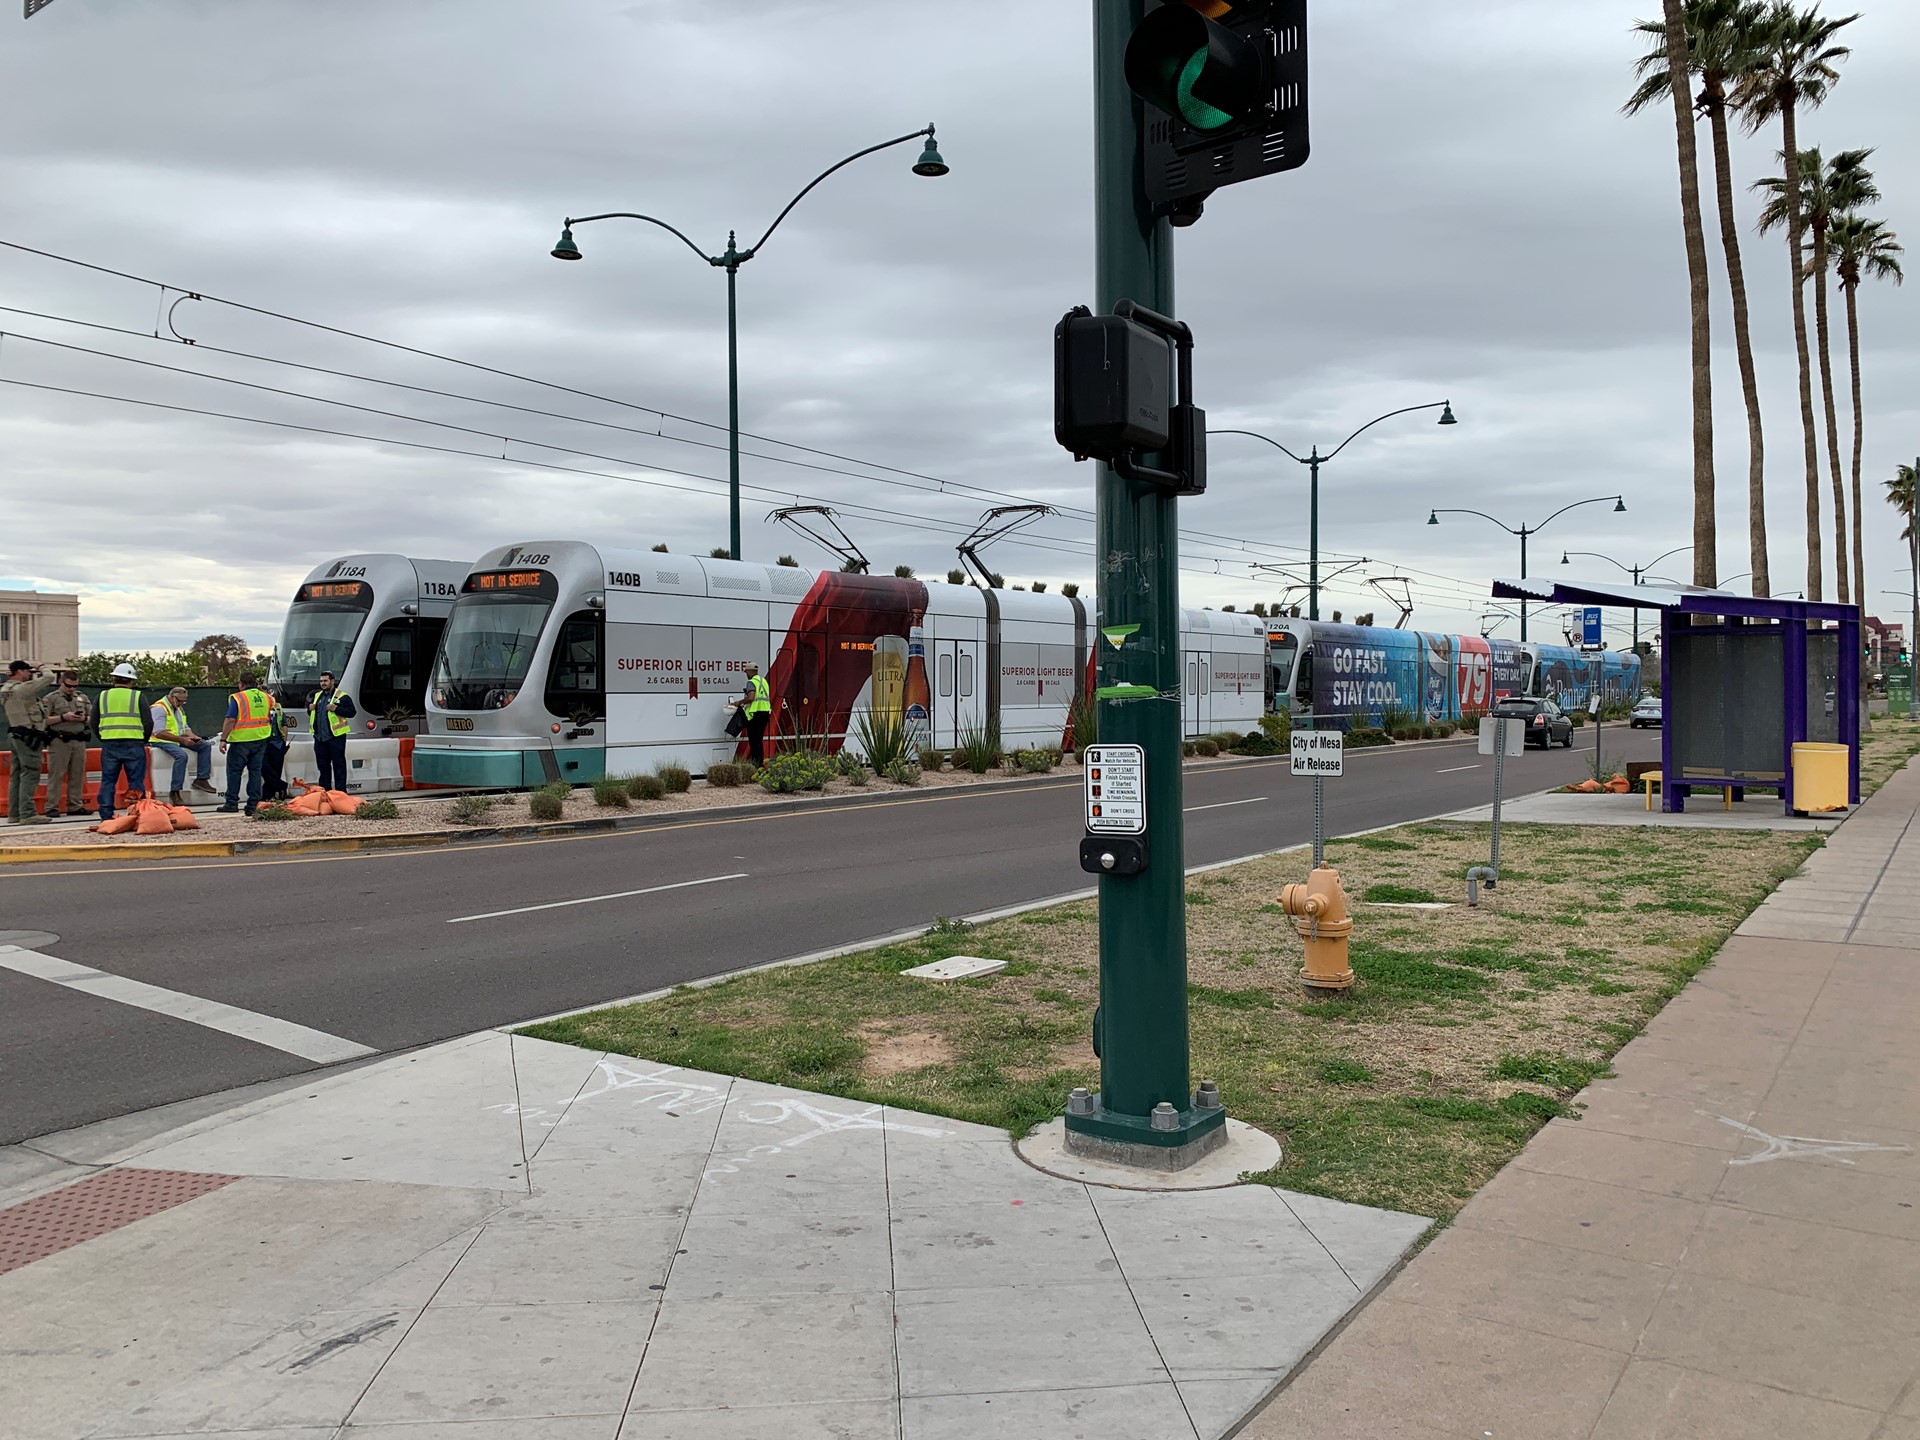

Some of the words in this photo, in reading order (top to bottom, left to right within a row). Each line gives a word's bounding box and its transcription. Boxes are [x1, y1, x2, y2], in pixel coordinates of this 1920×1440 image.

[517, 554, 550, 565] 140B
[339, 567, 366, 577] 118A
[481, 576, 494, 588] NOT
[498, 575, 507, 588] IN
[509, 573, 541, 587] SERVICE
[608, 572, 641, 587] 140B
[424, 582, 457, 596] 118A
[1333, 647, 1353, 674] GO
[1355, 649, 1387, 674] FAST.
[1494, 650, 1503, 664] ALL
[617, 658, 683, 671] SUPERIOR
[687, 660, 722, 672] LIGHT
[726, 661, 752, 672] BEE
[1001, 667, 1036, 676] SUPERIOR
[1037, 668, 1056, 677] LIGHT
[1057, 668, 1074, 677] BEER
[647, 676, 659, 685] 2.6
[660, 677, 684, 685] CARBS
[702, 677, 712, 685] 95
[713, 677, 731, 685] CALS
[877, 671, 905, 682] ULTRA
[1215, 671, 1237, 680] SUPERIOR
[1494, 667, 1510, 681] EVERY
[1332, 680, 1365, 706] STAY
[446, 717, 474, 731] METRO
[1292, 736, 1308, 751] City
[1309, 736, 1318, 749] of
[1319, 736, 1341, 749] Mesa
[1293, 757, 1306, 770] Air
[1307, 757, 1341, 771] Release
